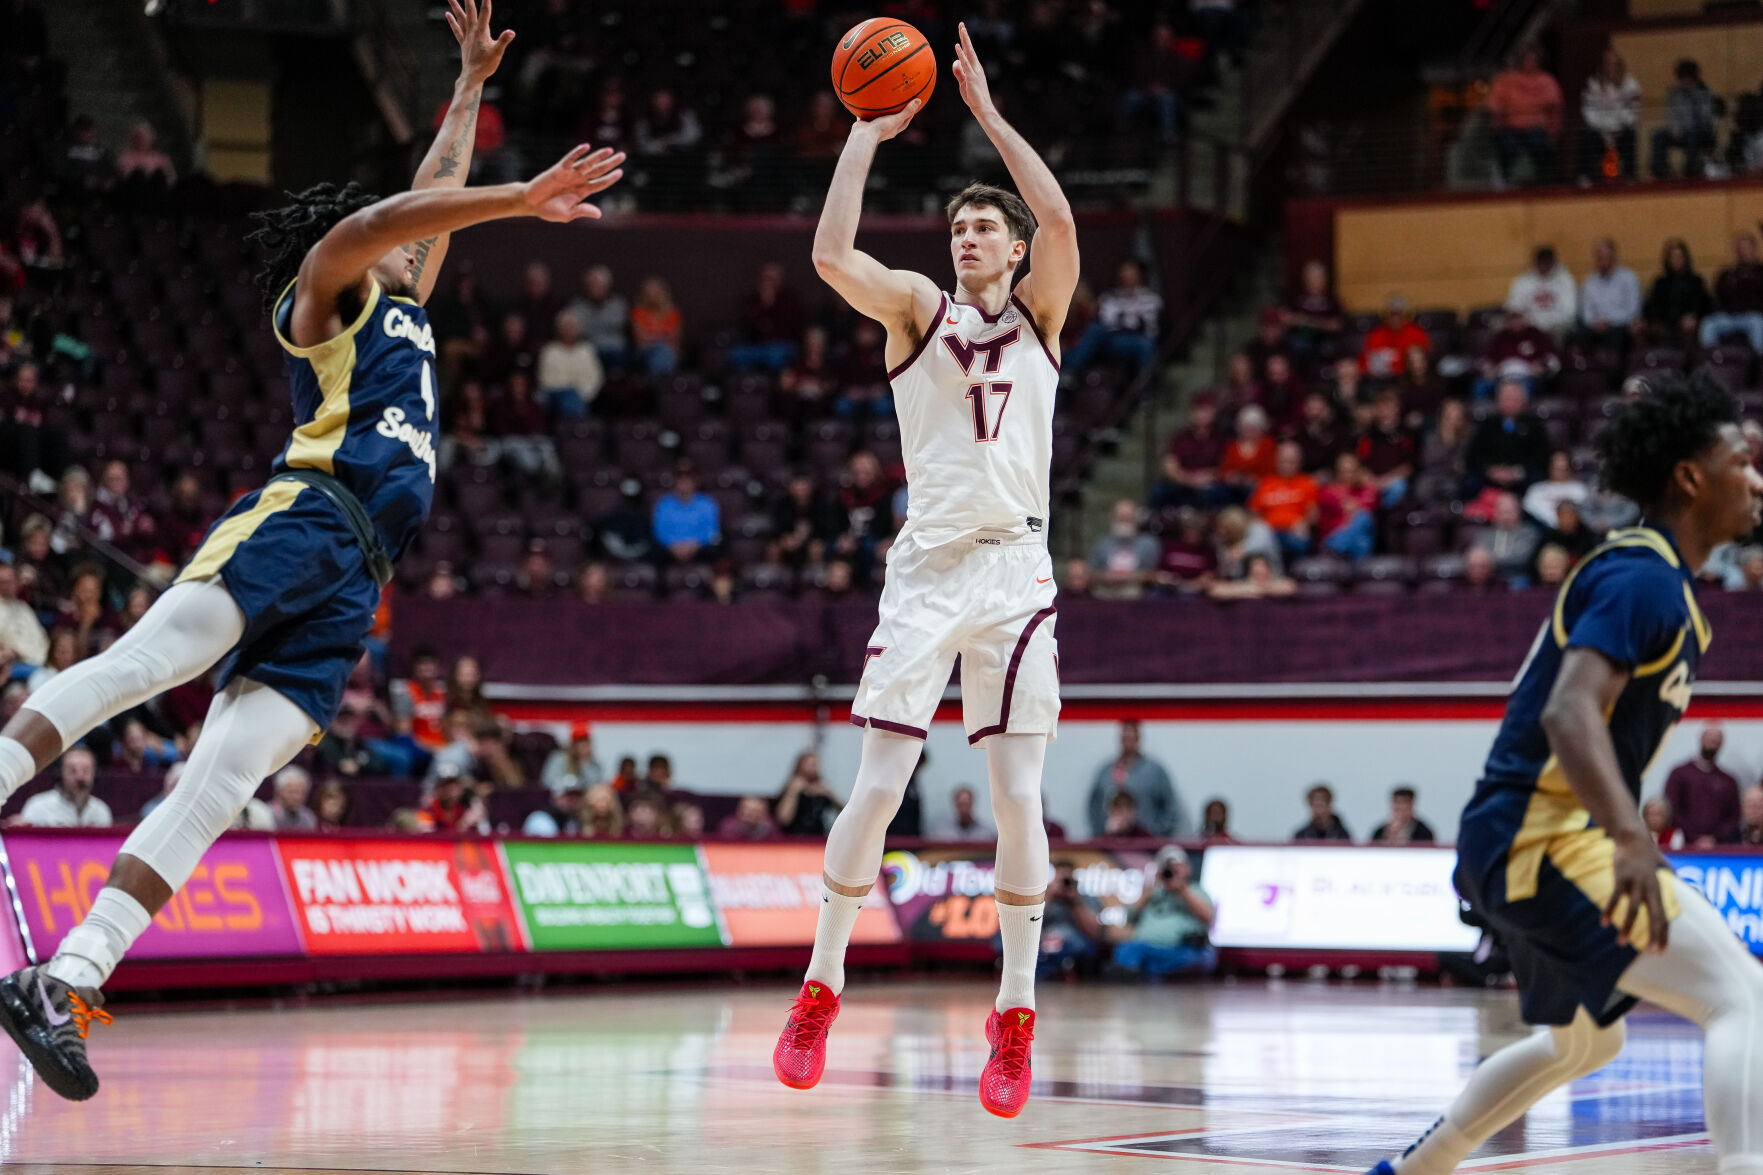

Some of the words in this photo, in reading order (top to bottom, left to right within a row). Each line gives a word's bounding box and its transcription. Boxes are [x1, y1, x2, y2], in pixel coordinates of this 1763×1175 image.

[856, 31, 909, 71] ELITE
[940, 324, 1022, 377] VT
[965, 381, 1014, 443] 17
[975, 538, 1001, 546] HOKIES
[291, 858, 363, 904] FAN
[354, 859, 460, 904] WORK
[406, 904, 469, 934] WORK
